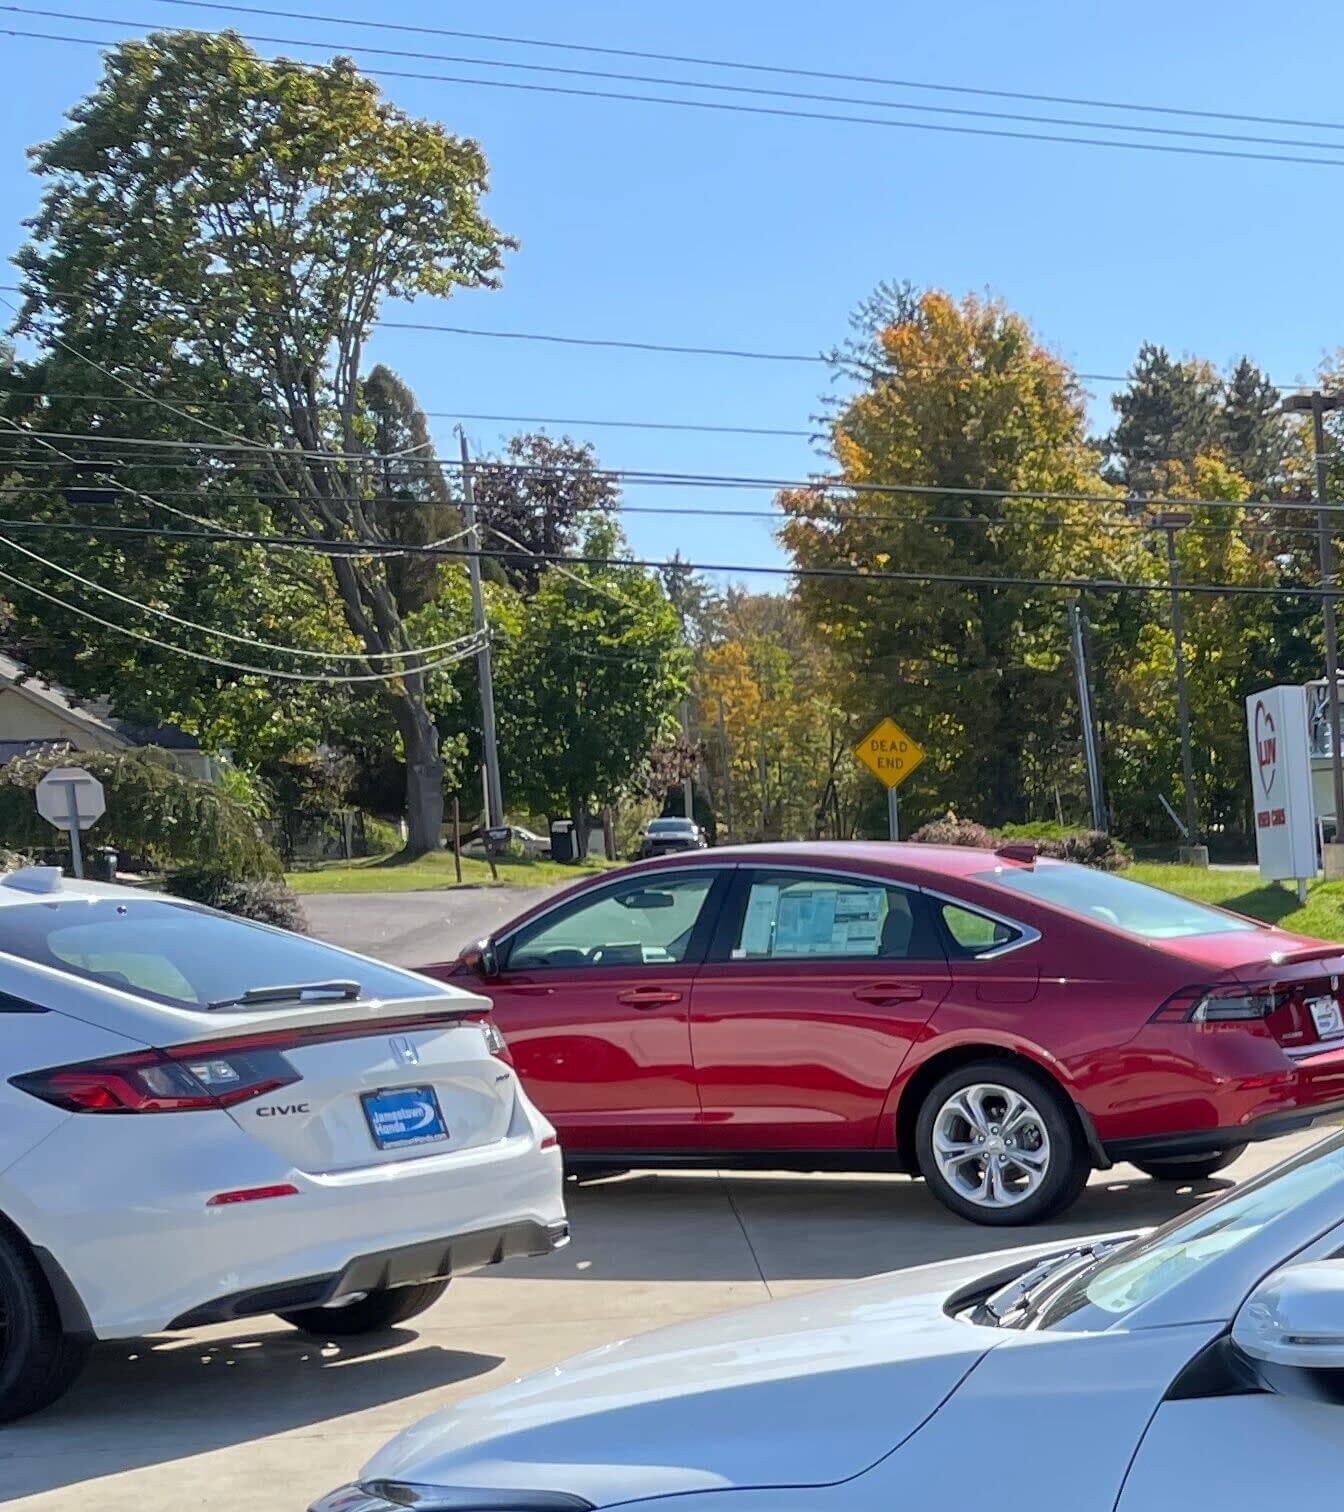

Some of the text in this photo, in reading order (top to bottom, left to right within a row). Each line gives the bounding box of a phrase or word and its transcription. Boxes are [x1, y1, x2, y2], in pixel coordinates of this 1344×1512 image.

[871, 740, 907, 752] DEAD
[1259, 737, 1276, 767] LUV
[877, 757, 903, 769] END
[256, 1103, 309, 1117] CIVIC
[373, 1108, 425, 1125] Jamestown
[375, 1120, 406, 1136] Honda
